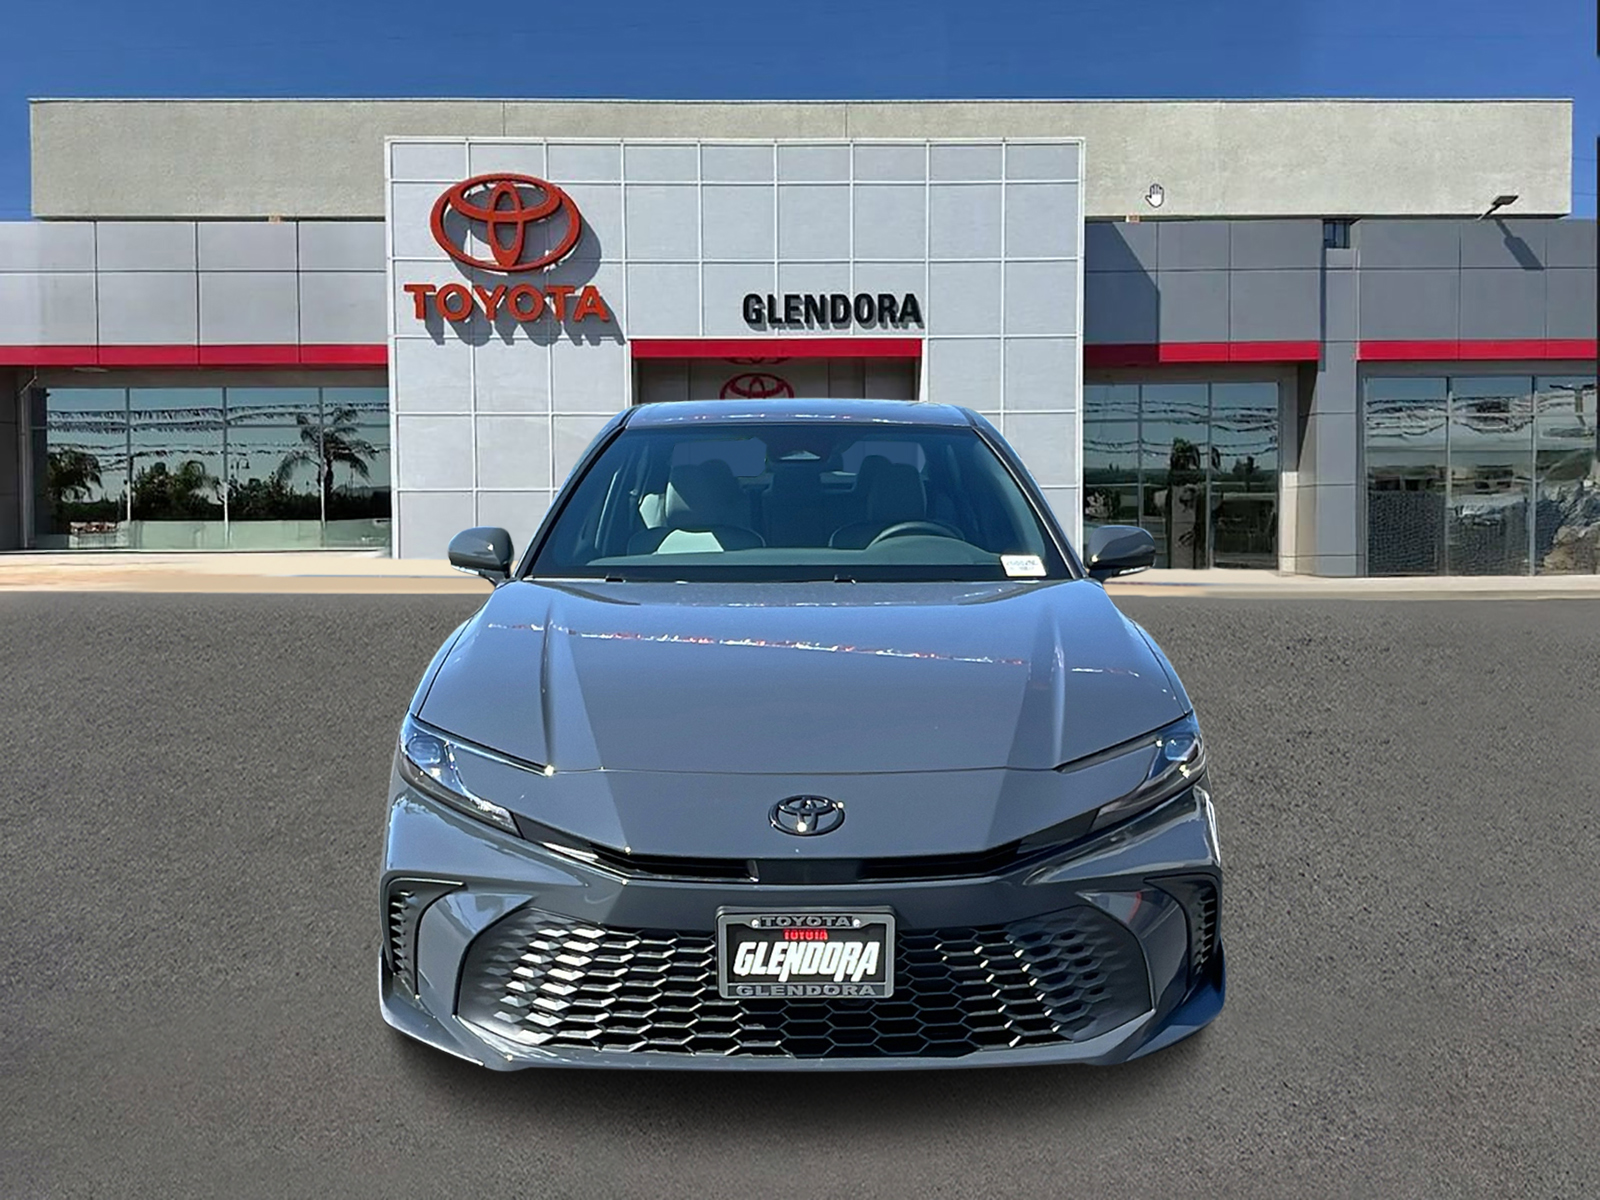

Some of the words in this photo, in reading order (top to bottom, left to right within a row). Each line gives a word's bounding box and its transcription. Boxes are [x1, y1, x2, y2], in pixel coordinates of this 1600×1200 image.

[404, 283, 610, 322] TOYOTA
[743, 292, 922, 324] GLENDORA
[761, 916, 851, 927] TOYOTA
[733, 941, 880, 982] GLENDORA
[736, 985, 876, 996] GLENDORA
